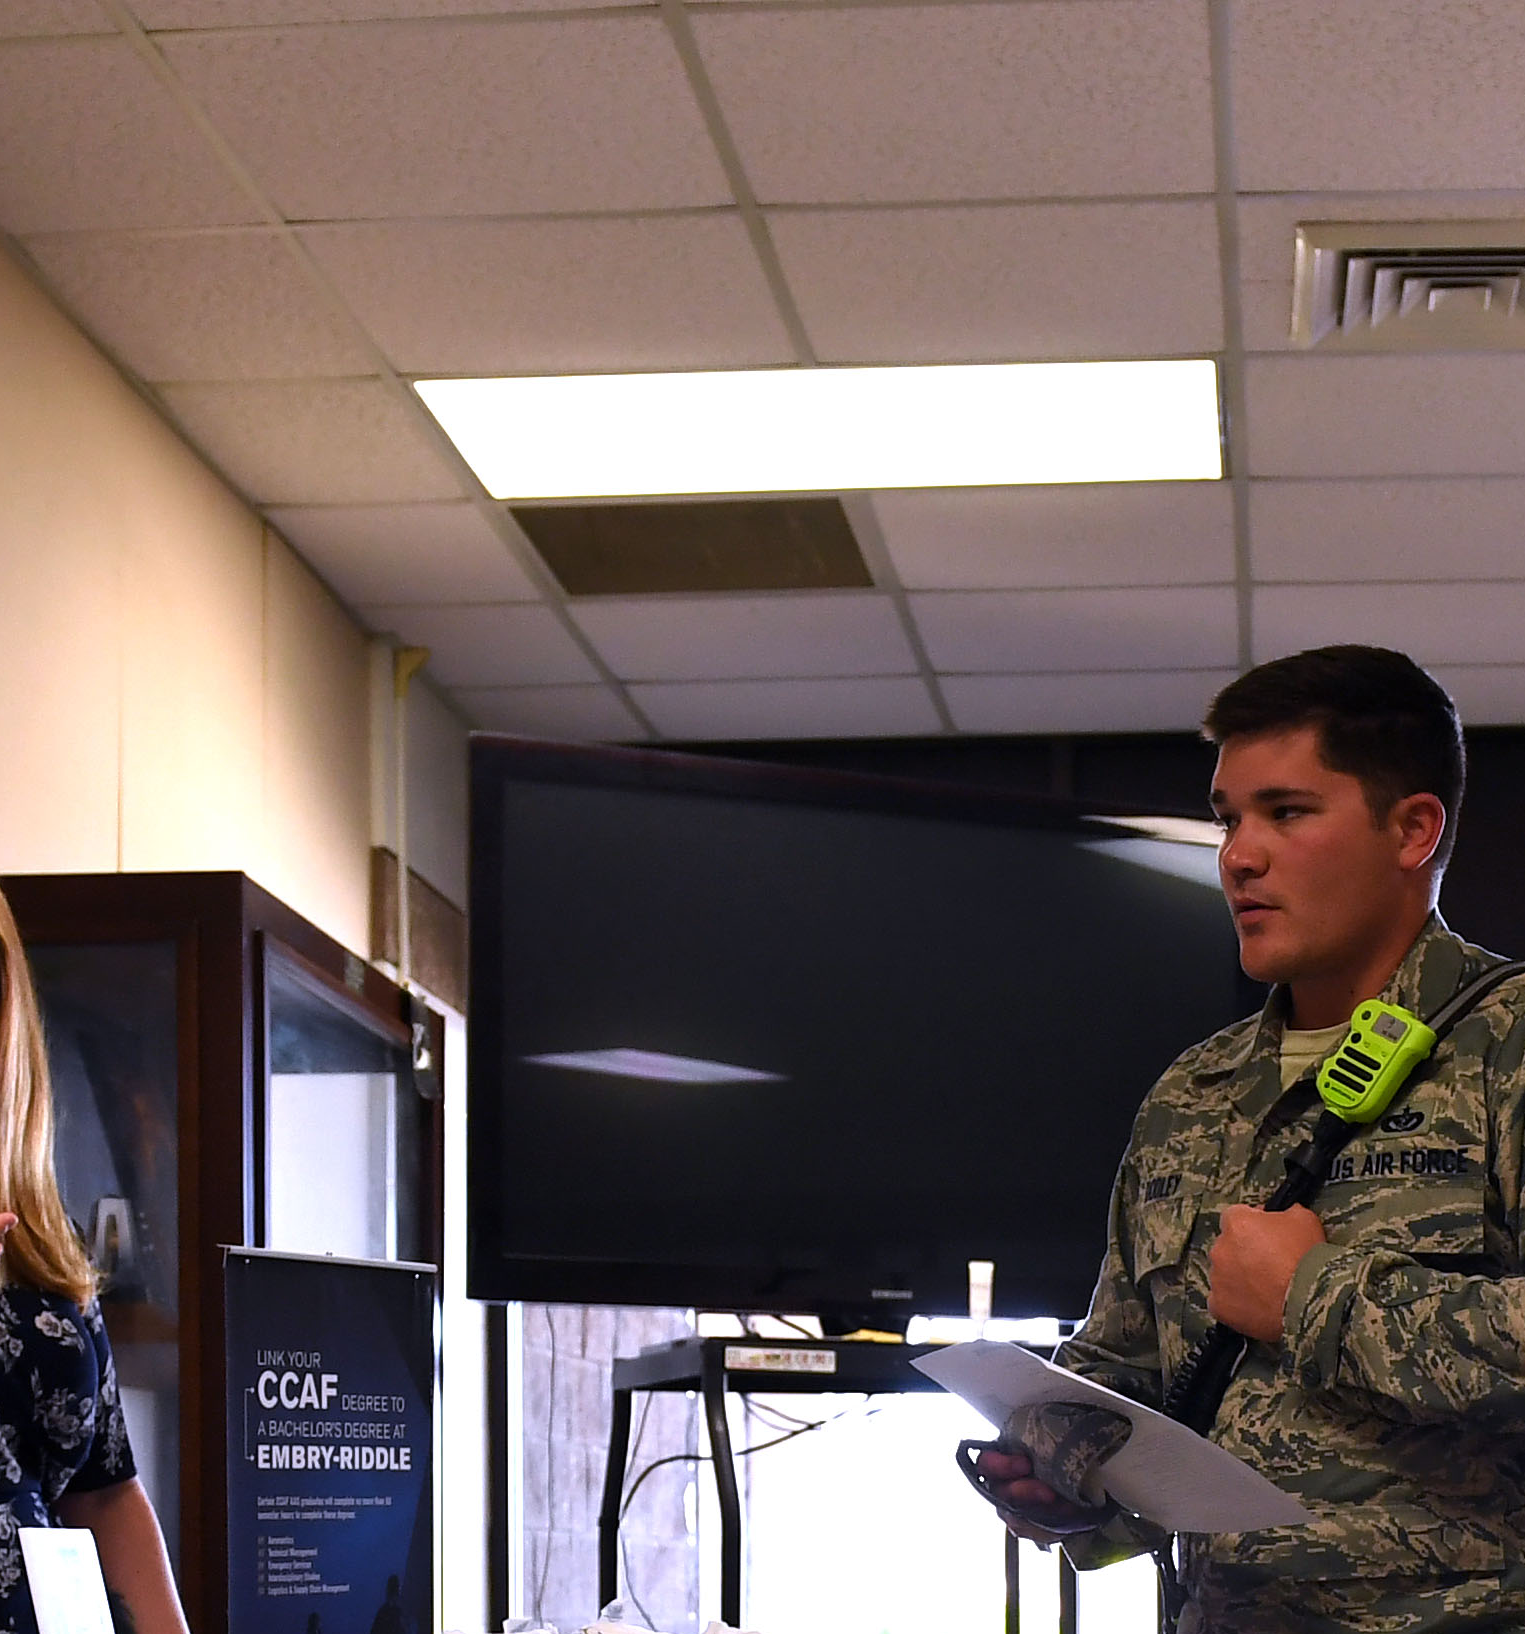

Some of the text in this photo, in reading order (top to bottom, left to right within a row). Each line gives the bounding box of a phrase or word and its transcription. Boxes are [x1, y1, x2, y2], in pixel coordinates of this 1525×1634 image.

[1361, 1152, 1394, 1177] AIR
[1400, 1148, 1470, 1174] FORCE
[257, 1350, 321, 1368] LINK YOUR
[257, 1370, 405, 1413] CCAF DEGREE TO
[257, 1421, 405, 1440] A BACHELOR'S DEGREE AT
[257, 1445, 412, 1471] EMBRY-RIDDLE
